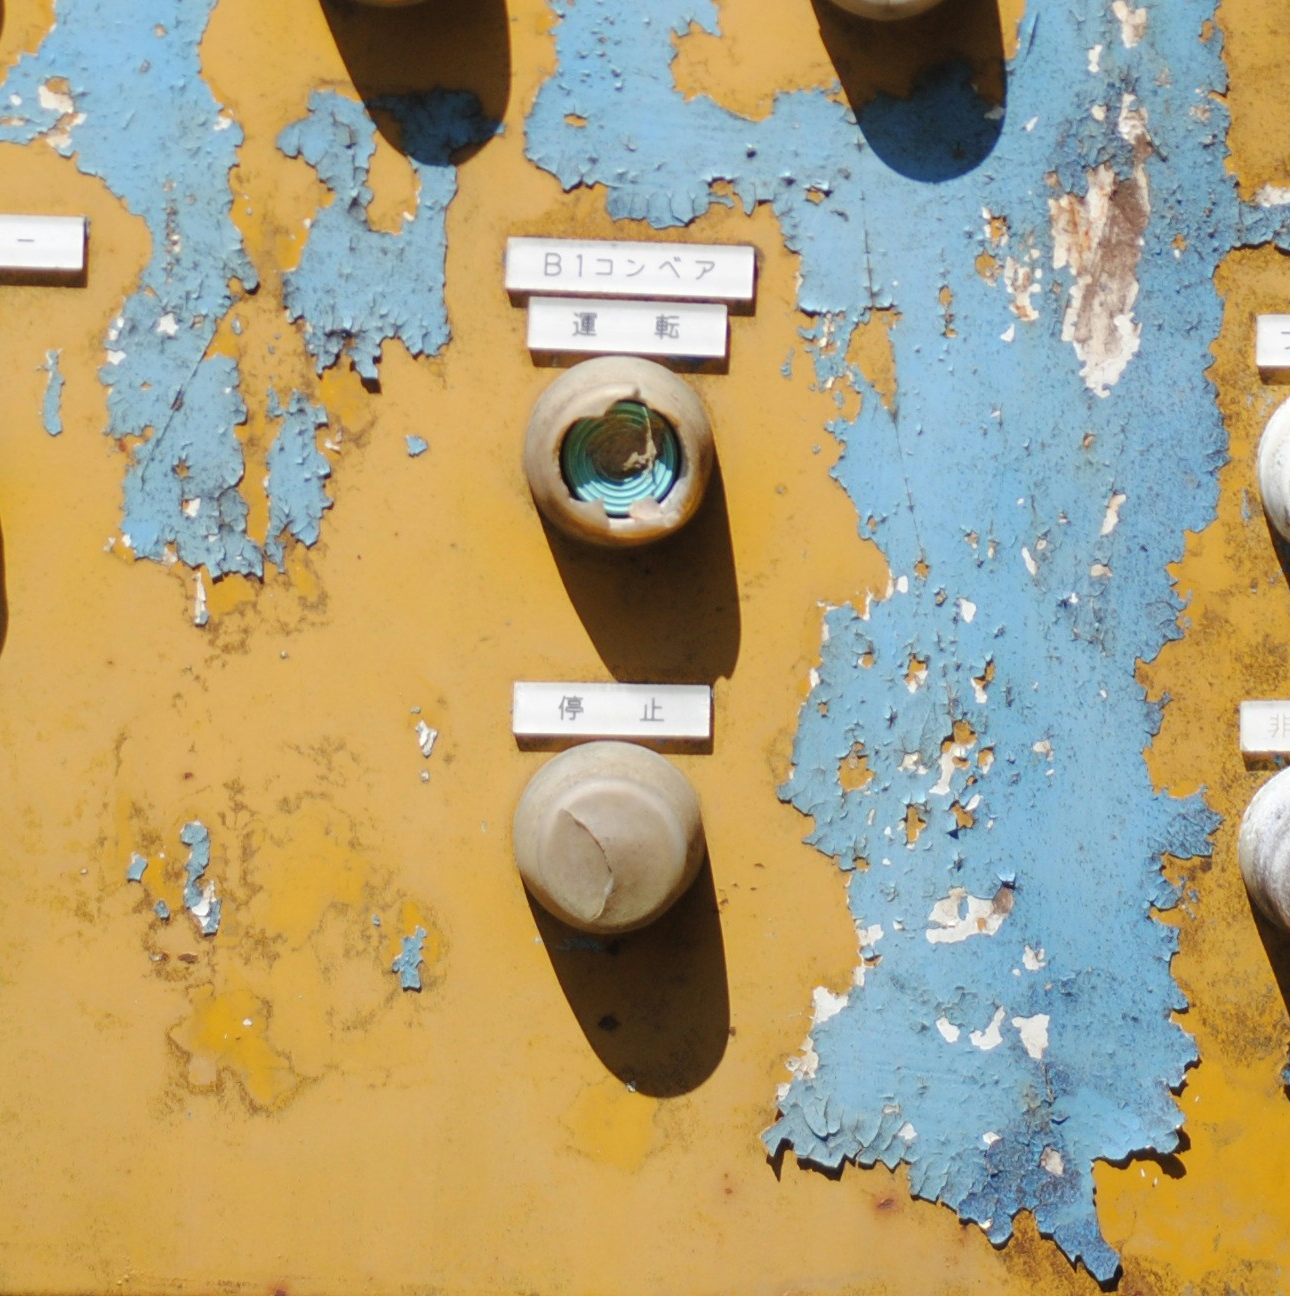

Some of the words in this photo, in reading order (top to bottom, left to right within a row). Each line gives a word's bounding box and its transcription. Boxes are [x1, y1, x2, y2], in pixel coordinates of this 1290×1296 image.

[543, 251, 716, 281] B1コンベア
[572, 311, 681, 340] 運転
[558, 694, 665, 723] 停止
